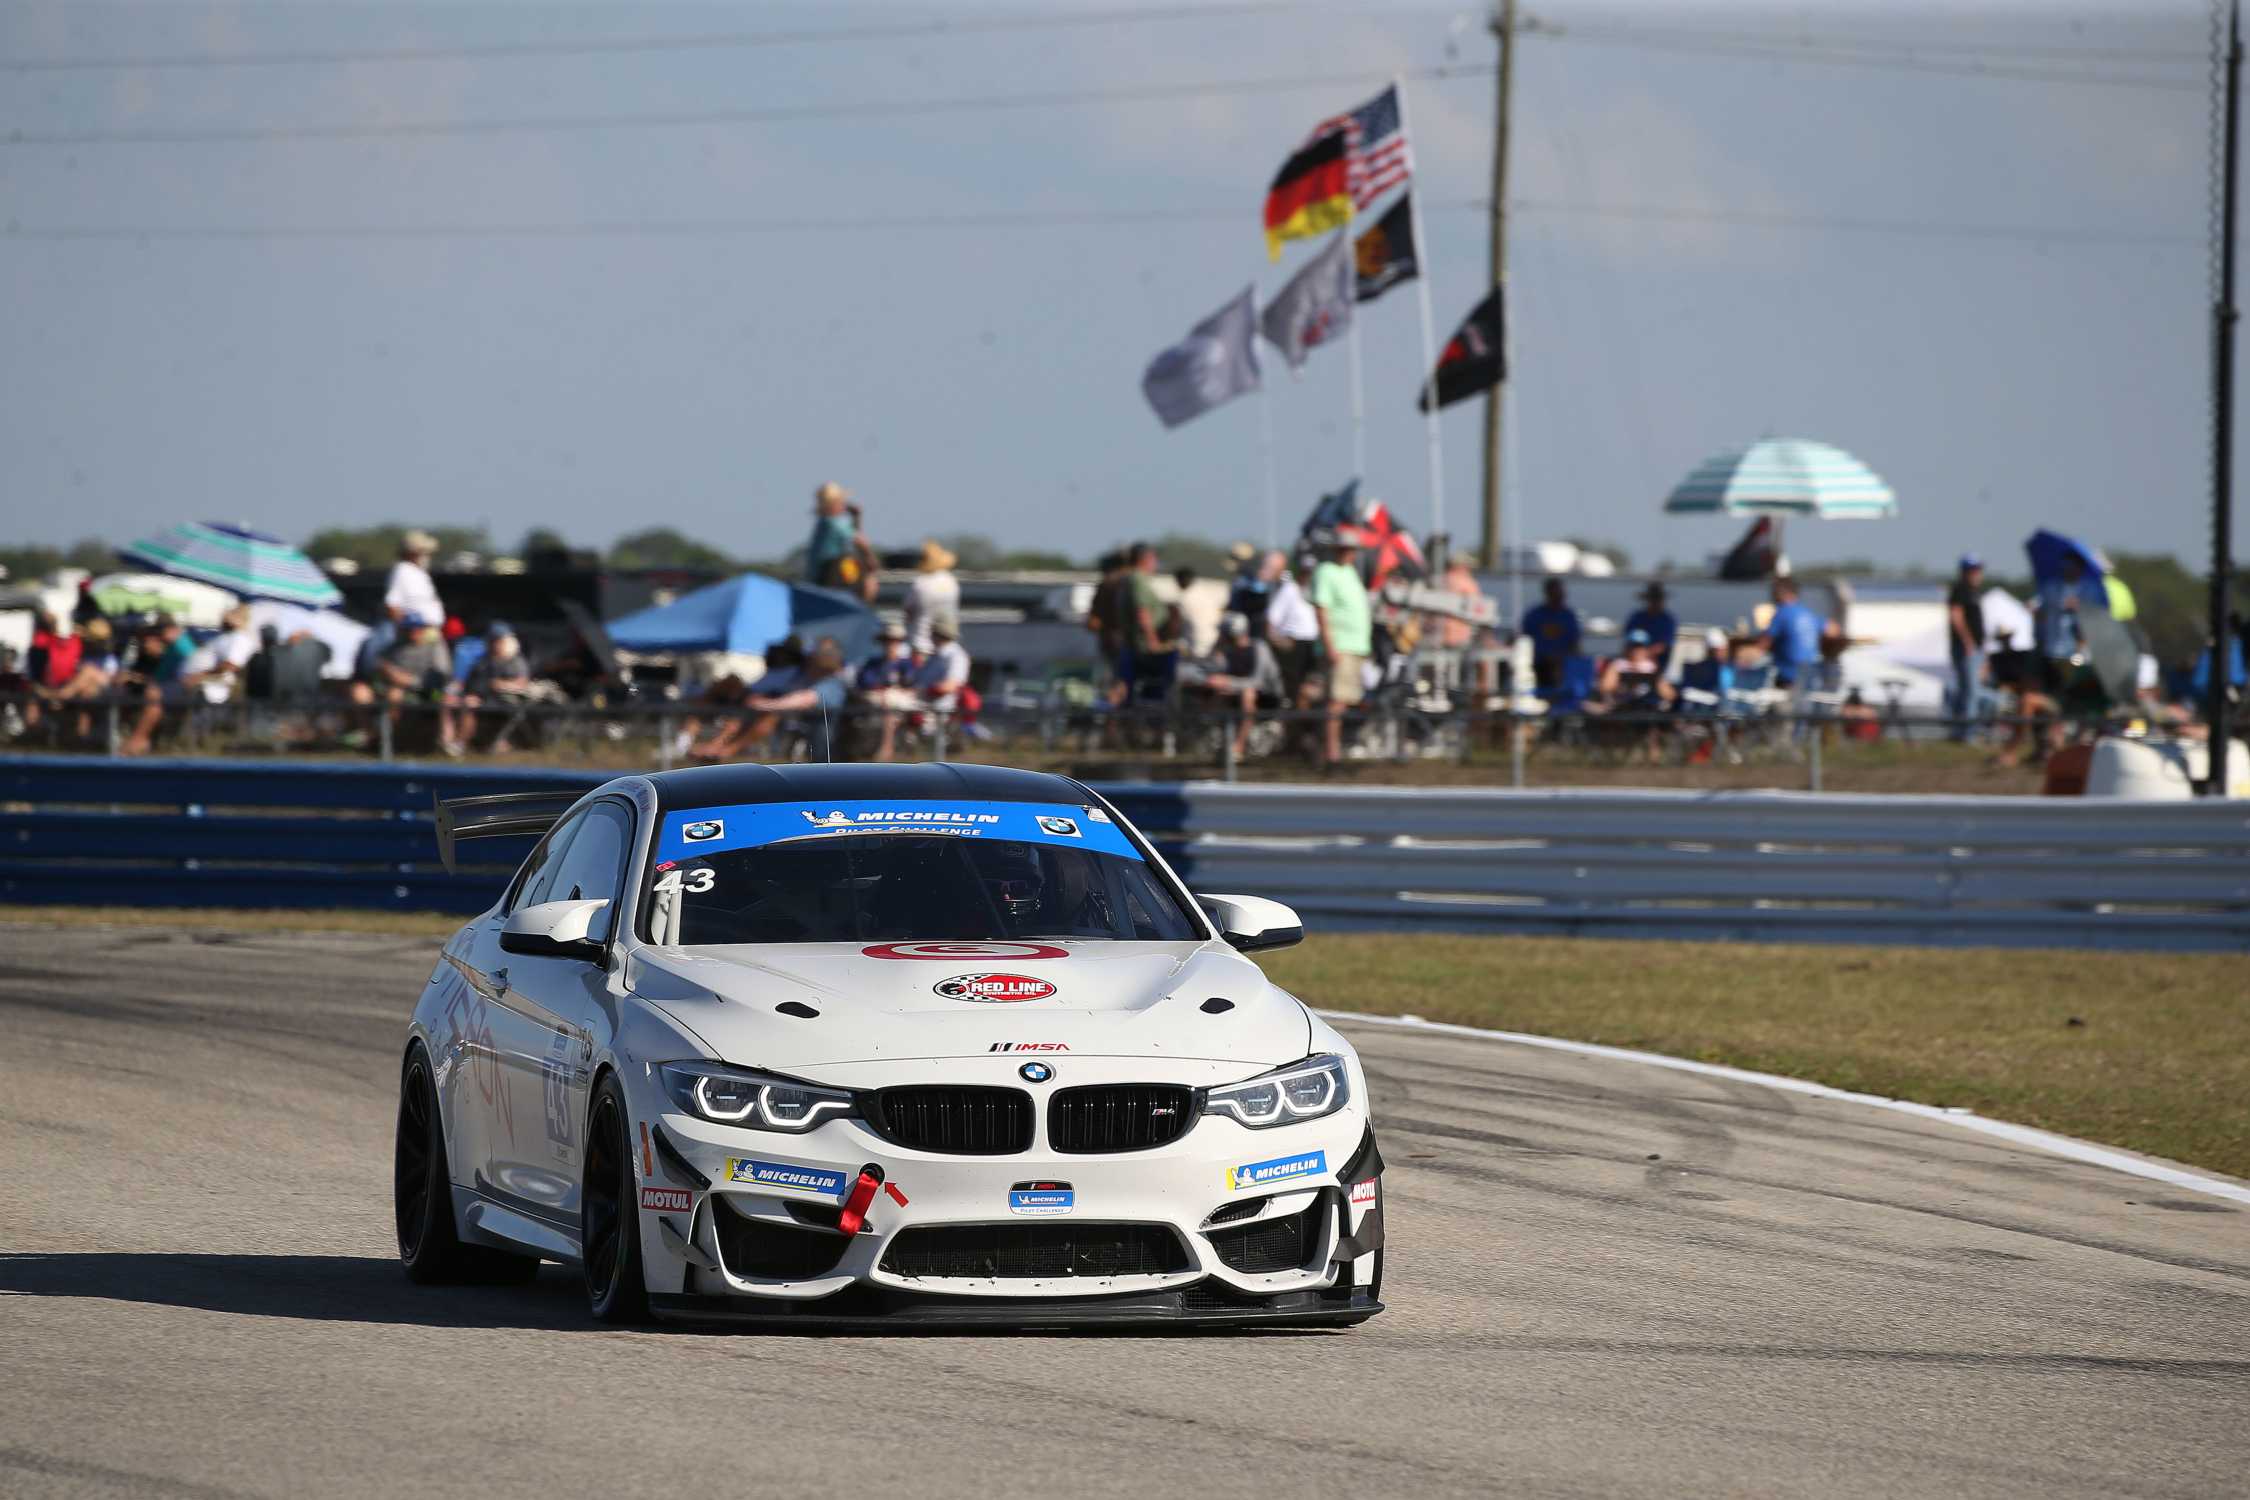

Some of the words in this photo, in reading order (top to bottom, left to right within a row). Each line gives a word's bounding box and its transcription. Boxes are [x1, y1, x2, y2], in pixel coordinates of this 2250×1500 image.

[857, 811, 1000, 823] MICHELIN
[889, 826, 982, 836] CENGE
[653, 868, 716, 894] 43
[971, 982, 1005, 992] RED
[1009, 982, 1046, 992] LINE
[1014, 1043, 1071, 1051] IMSA
[758, 1169, 836, 1188] MICHELIN
[1255, 1158, 1319, 1180] MICHELIN
[643, 1190, 689, 1209] MOTUL
[1352, 1181, 1376, 1200] MOTU
